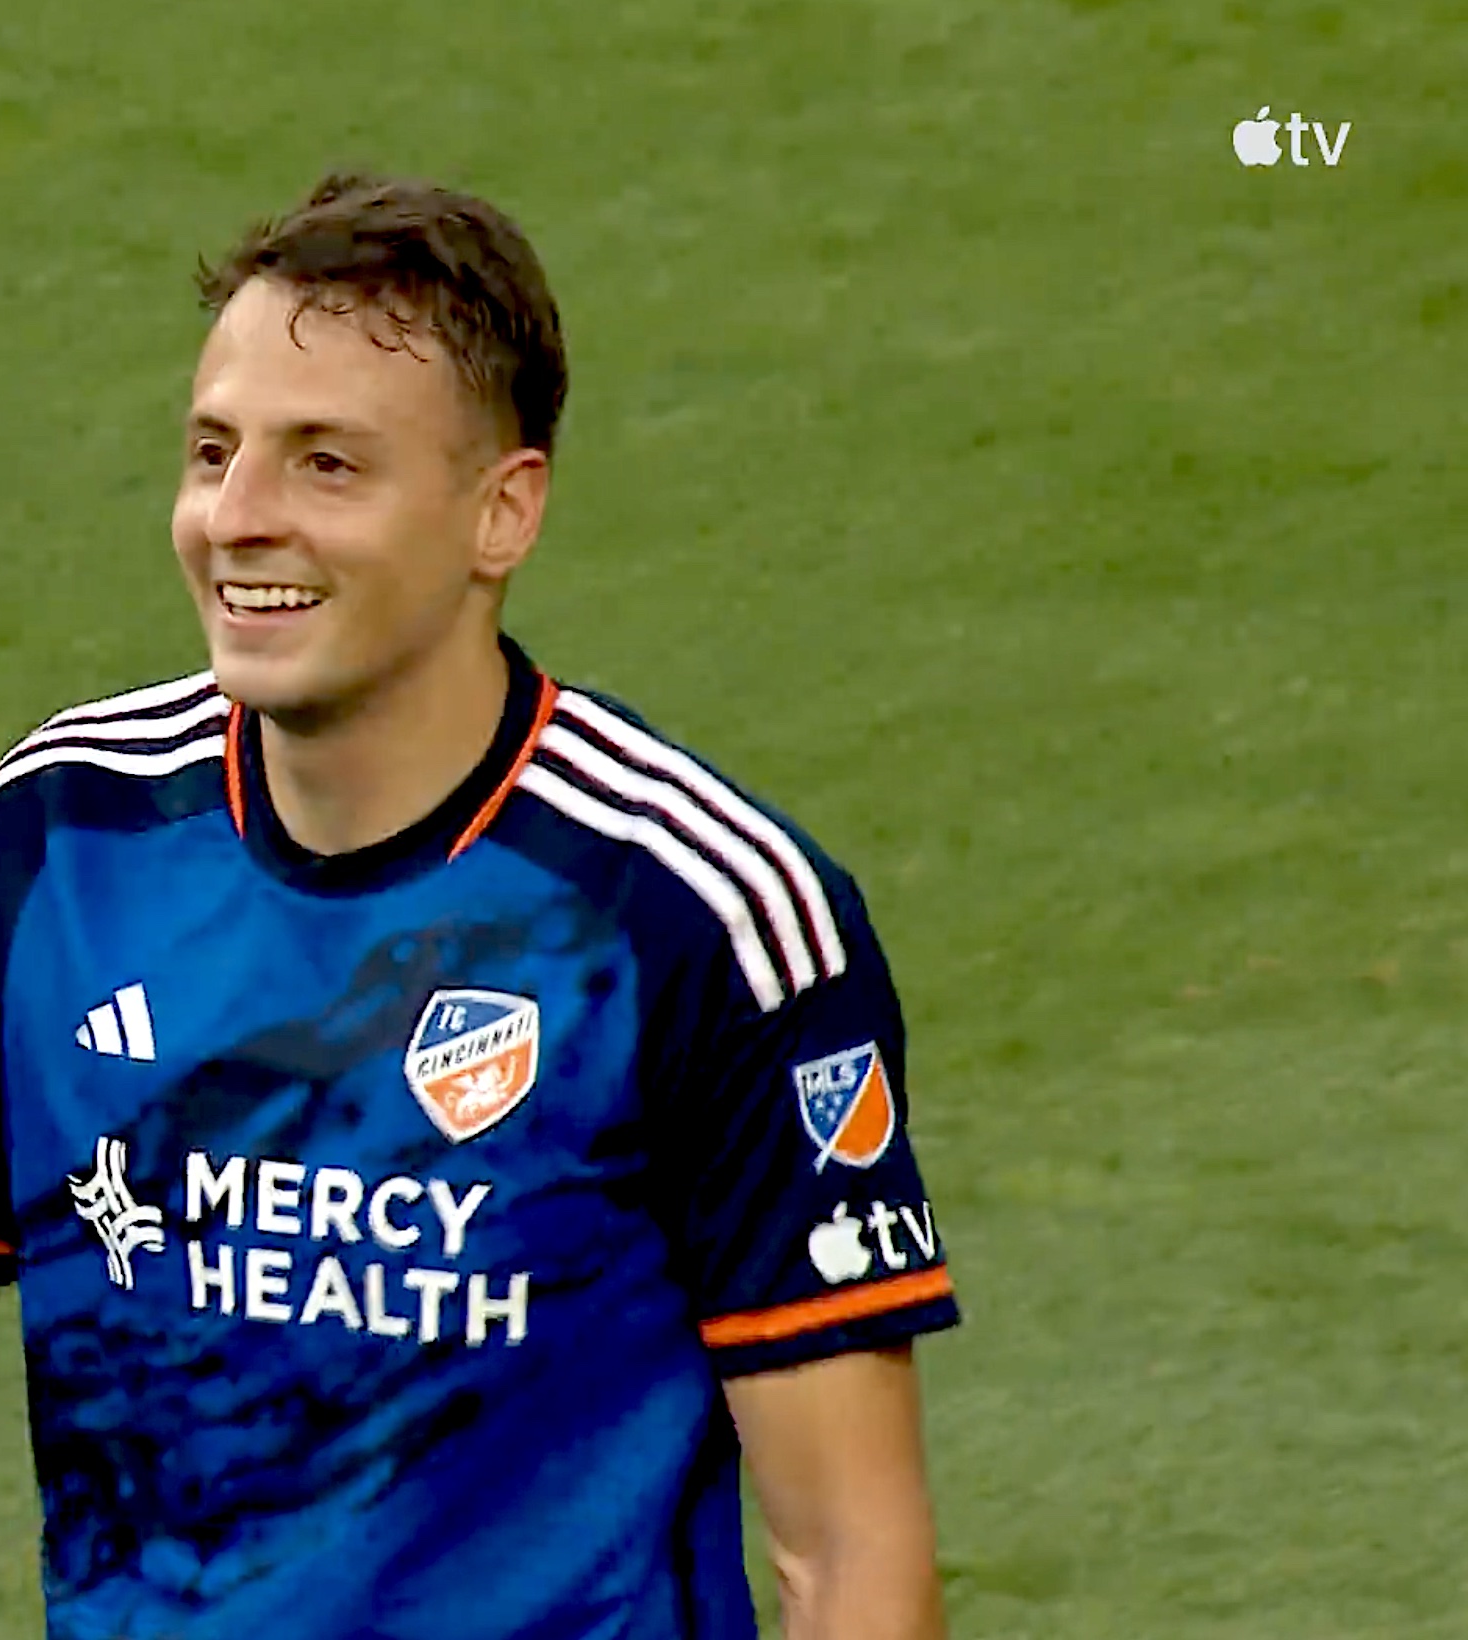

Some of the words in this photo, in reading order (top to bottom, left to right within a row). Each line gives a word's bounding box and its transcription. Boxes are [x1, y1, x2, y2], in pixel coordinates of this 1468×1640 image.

[185, 1150, 492, 1260] MERCY
[867, 1199, 935, 1270] tv
[188, 1239, 530, 1348] HEALTH
